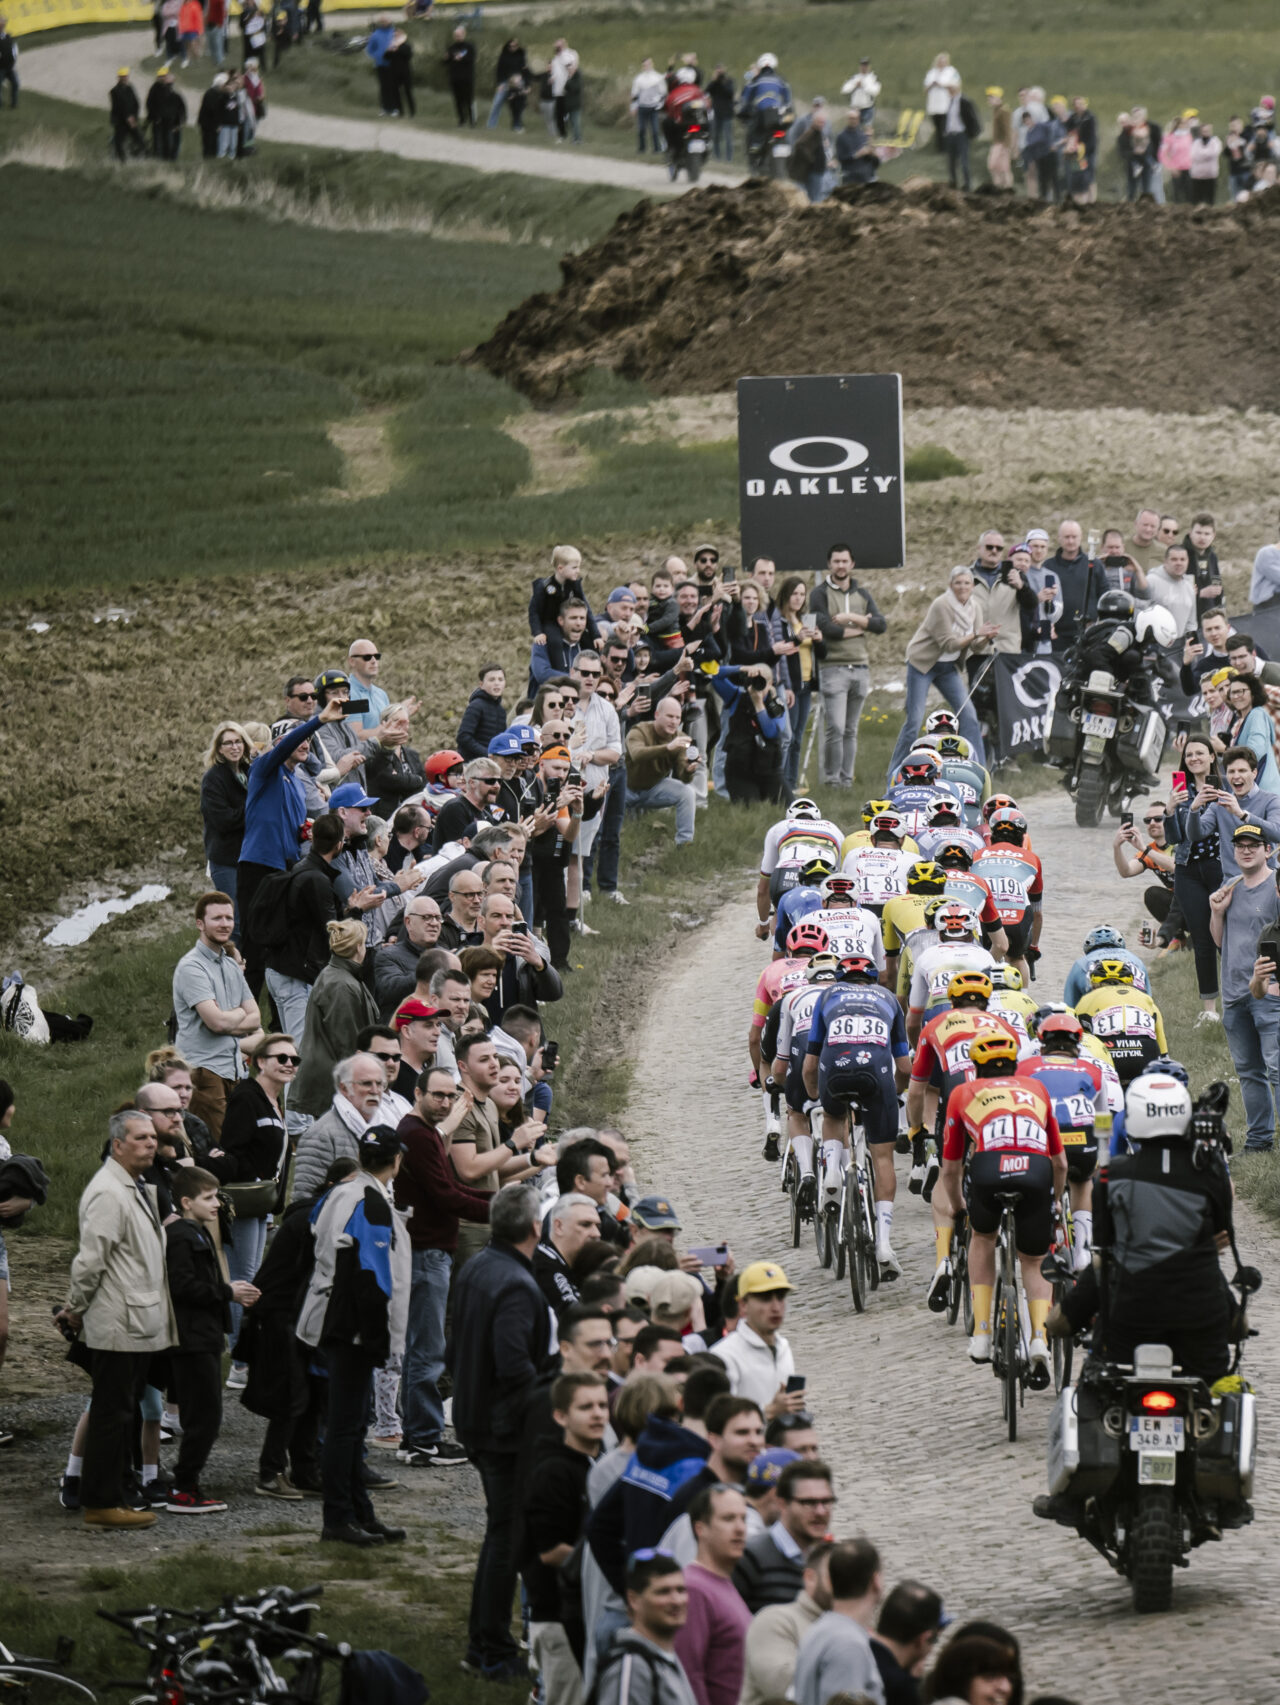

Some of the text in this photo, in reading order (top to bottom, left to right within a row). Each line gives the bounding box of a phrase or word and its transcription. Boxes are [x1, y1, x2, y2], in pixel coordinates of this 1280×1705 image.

[746, 476, 894, 497] OAKLEY
[884, 877, 901, 893] 81
[1000, 879, 1022, 896] 191
[845, 938, 866, 954] 88
[833, 1018, 884, 1037] 36 36
[1134, 1011, 1152, 1028] 13
[952, 1043, 970, 1062] 76
[1116, 1040, 1143, 1048] VISMA
[1071, 1098, 1093, 1116] 26
[989, 1118, 1041, 1140] 77 77
[1003, 1155, 1029, 1171] MOT
